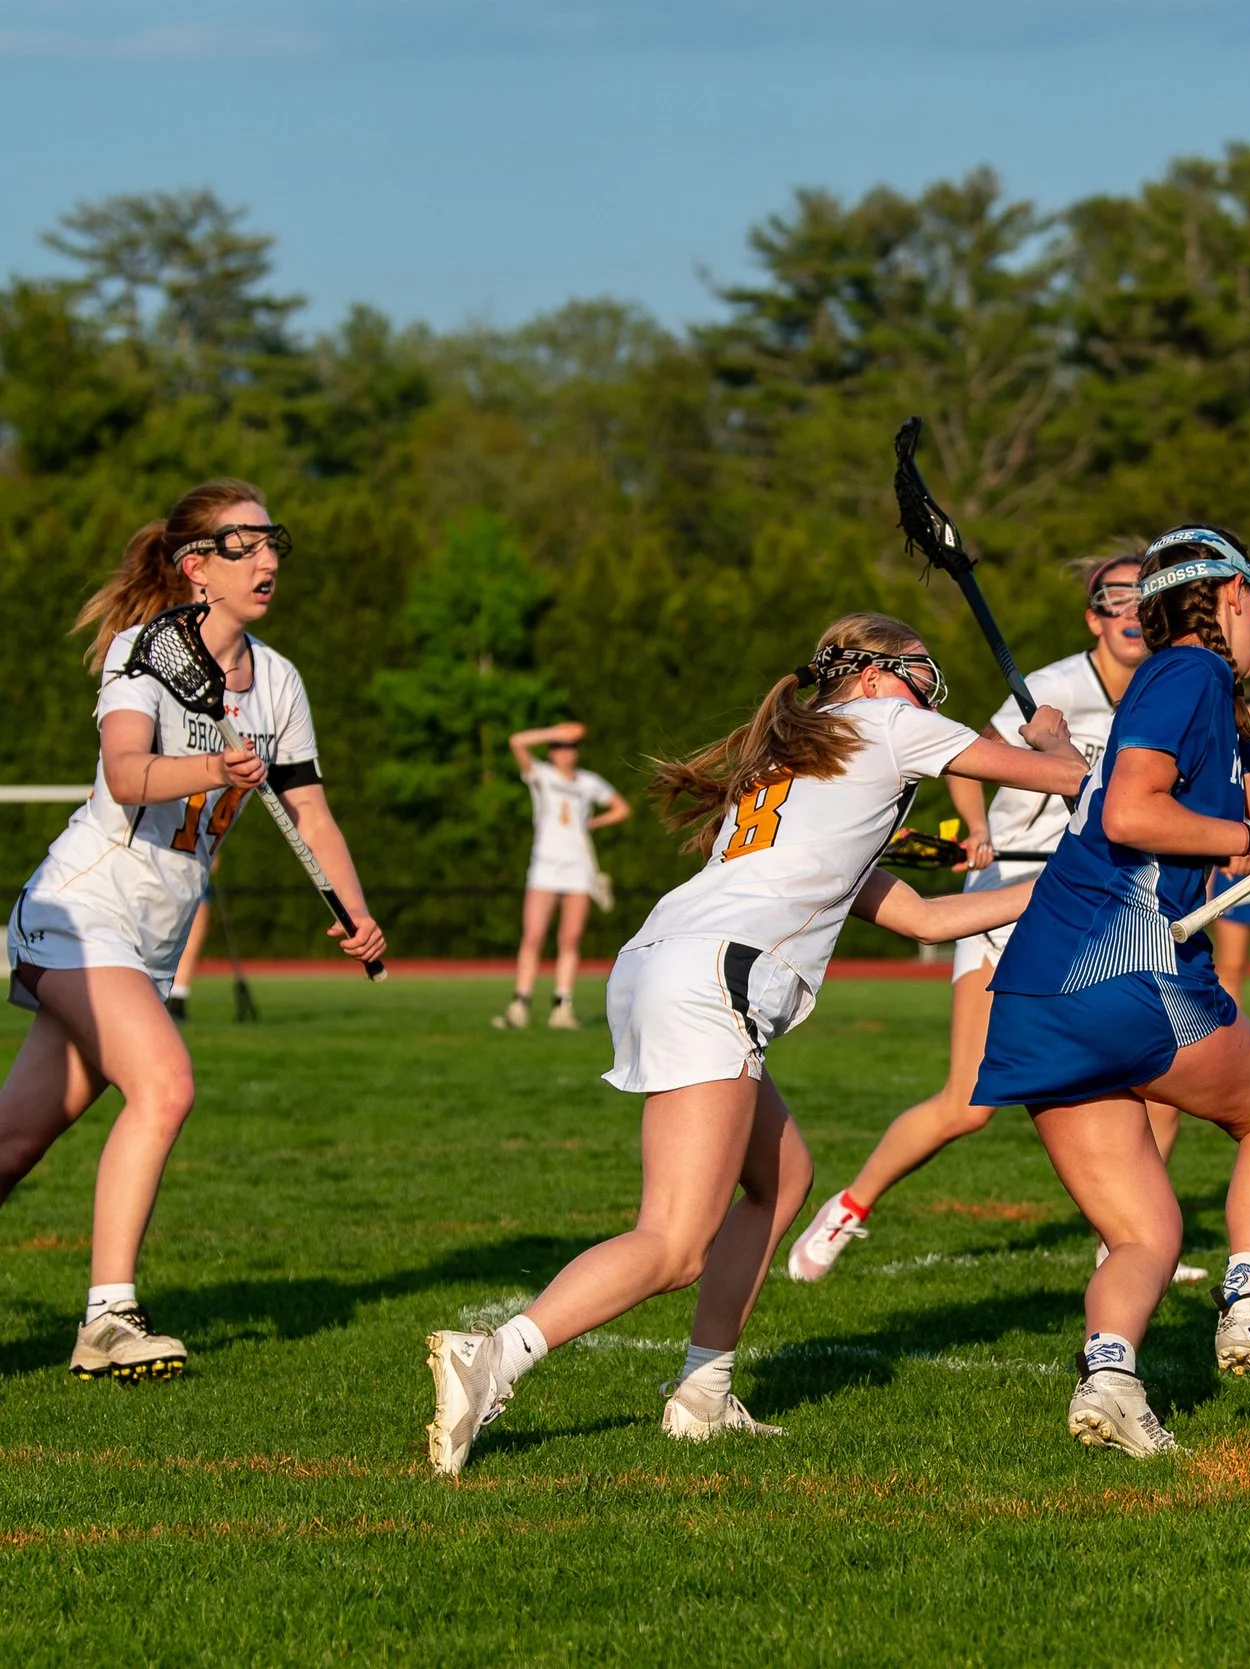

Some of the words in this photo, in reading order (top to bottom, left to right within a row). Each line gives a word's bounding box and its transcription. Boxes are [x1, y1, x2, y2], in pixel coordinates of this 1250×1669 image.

[1142, 562, 1209, 597] ACROSSE
[826, 662, 859, 679] STX
[872, 658, 901, 669] ST
[720, 764, 795, 863] 8
